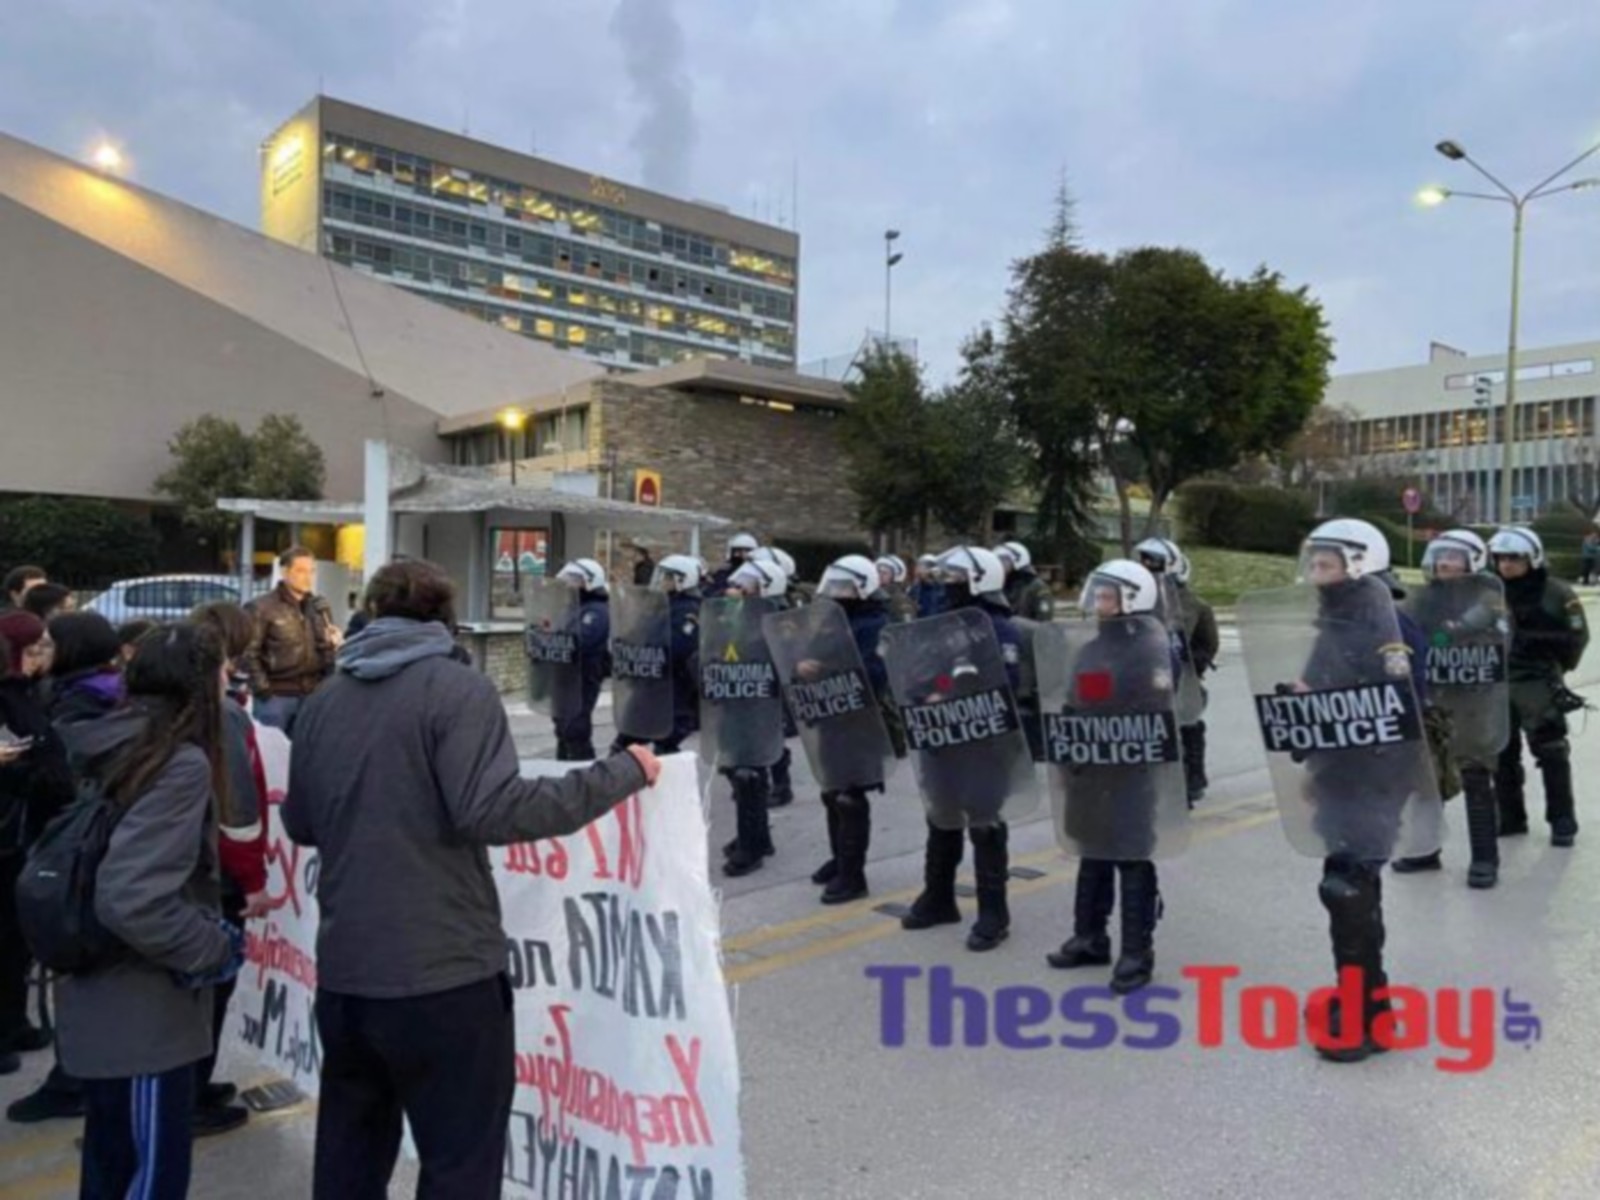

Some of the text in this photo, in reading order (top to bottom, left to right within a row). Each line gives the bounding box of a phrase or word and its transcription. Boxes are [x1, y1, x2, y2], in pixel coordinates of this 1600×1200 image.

[1426, 645, 1500, 668] ΥΝΟΜΙΑ
[705, 681, 771, 699] POLICE
[1424, 667, 1495, 684] LICE
[795, 693, 866, 720] POLICE
[904, 690, 1009, 731] ΑΣΤΥΝΟΜΙΑ
[1263, 683, 1406, 727] ΑΣΤΥΝΟΜΙΑ
[913, 715, 1009, 748] POLICE
[1050, 713, 1170, 744] ΑΣΤΥΝΟΜΙΑ
[1270, 716, 1403, 750] POLICE
[1054, 742, 1164, 764] POLICE
